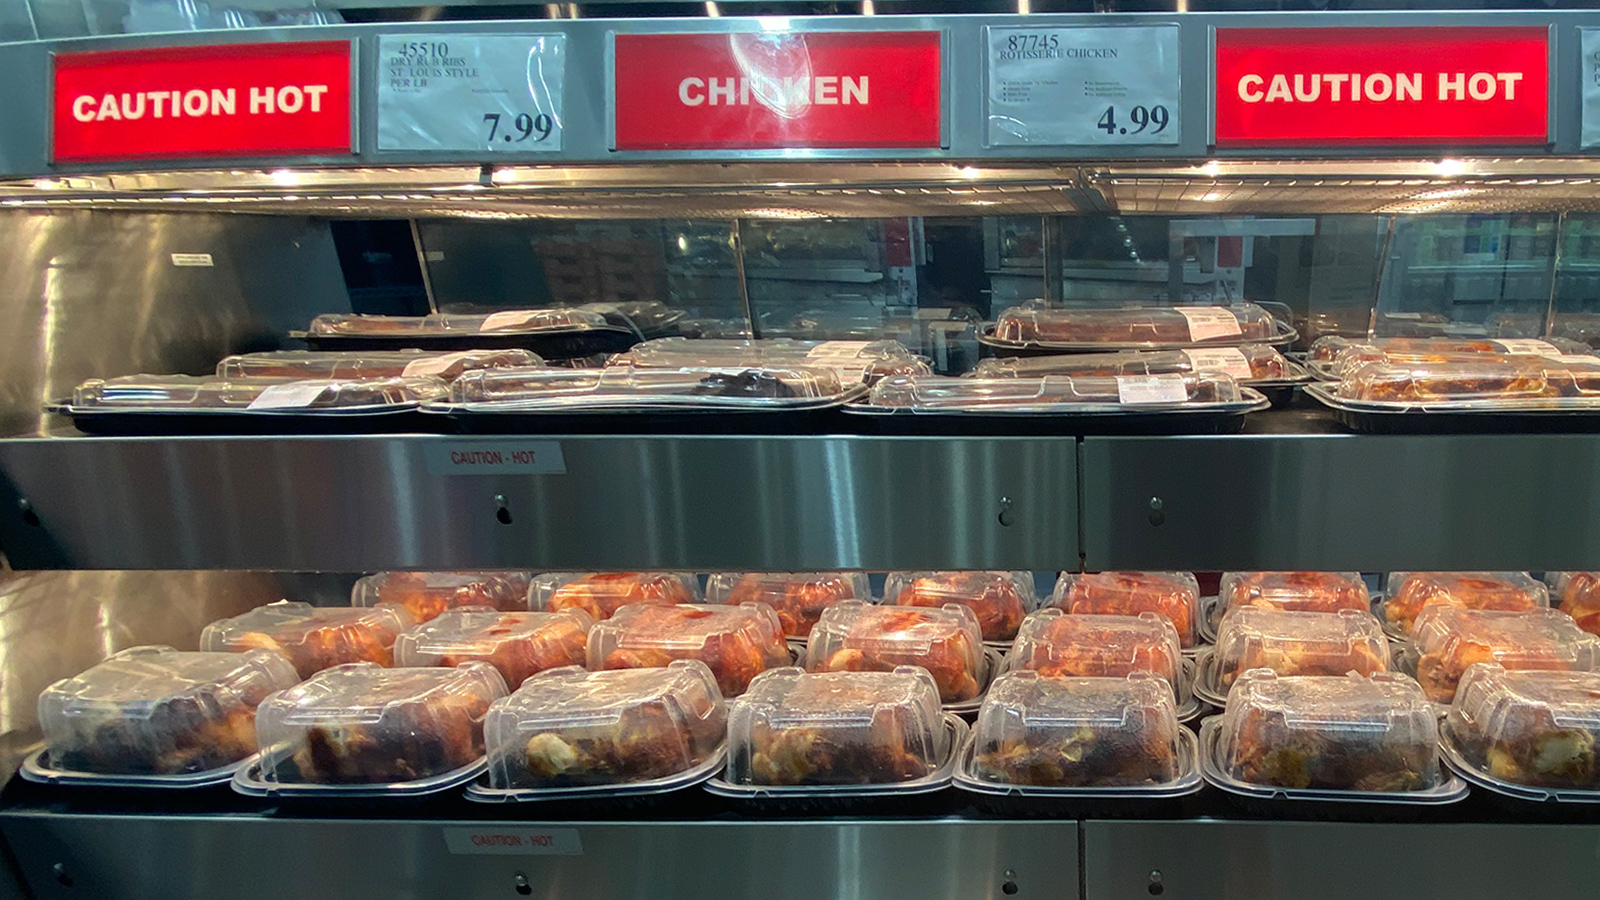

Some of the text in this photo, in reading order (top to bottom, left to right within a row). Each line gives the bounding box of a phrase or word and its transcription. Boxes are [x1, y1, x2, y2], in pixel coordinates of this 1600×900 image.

[399, 42, 449, 58] 45510
[1008, 35, 1059, 51] 87745
[1000, 48, 1118, 60] ROTISSERIE CHICKEN
[391, 57, 466, 67] DRY RUB RIBS
[410, 68, 442, 77] LOUIS
[445, 68, 479, 77] STYLE
[390, 79, 427, 88] PER LB
[1237, 72, 1523, 103] CAUTION HOT
[73, 85, 328, 122] CAUTION HOT
[483, 113, 552, 142] 7.99
[1098, 105, 1169, 135] 4.99
[451, 451, 503, 465] CAUTION
[512, 451, 536, 463] HOT
[471, 834, 522, 847] CAUTION
[530, 835, 554, 847] HOT
